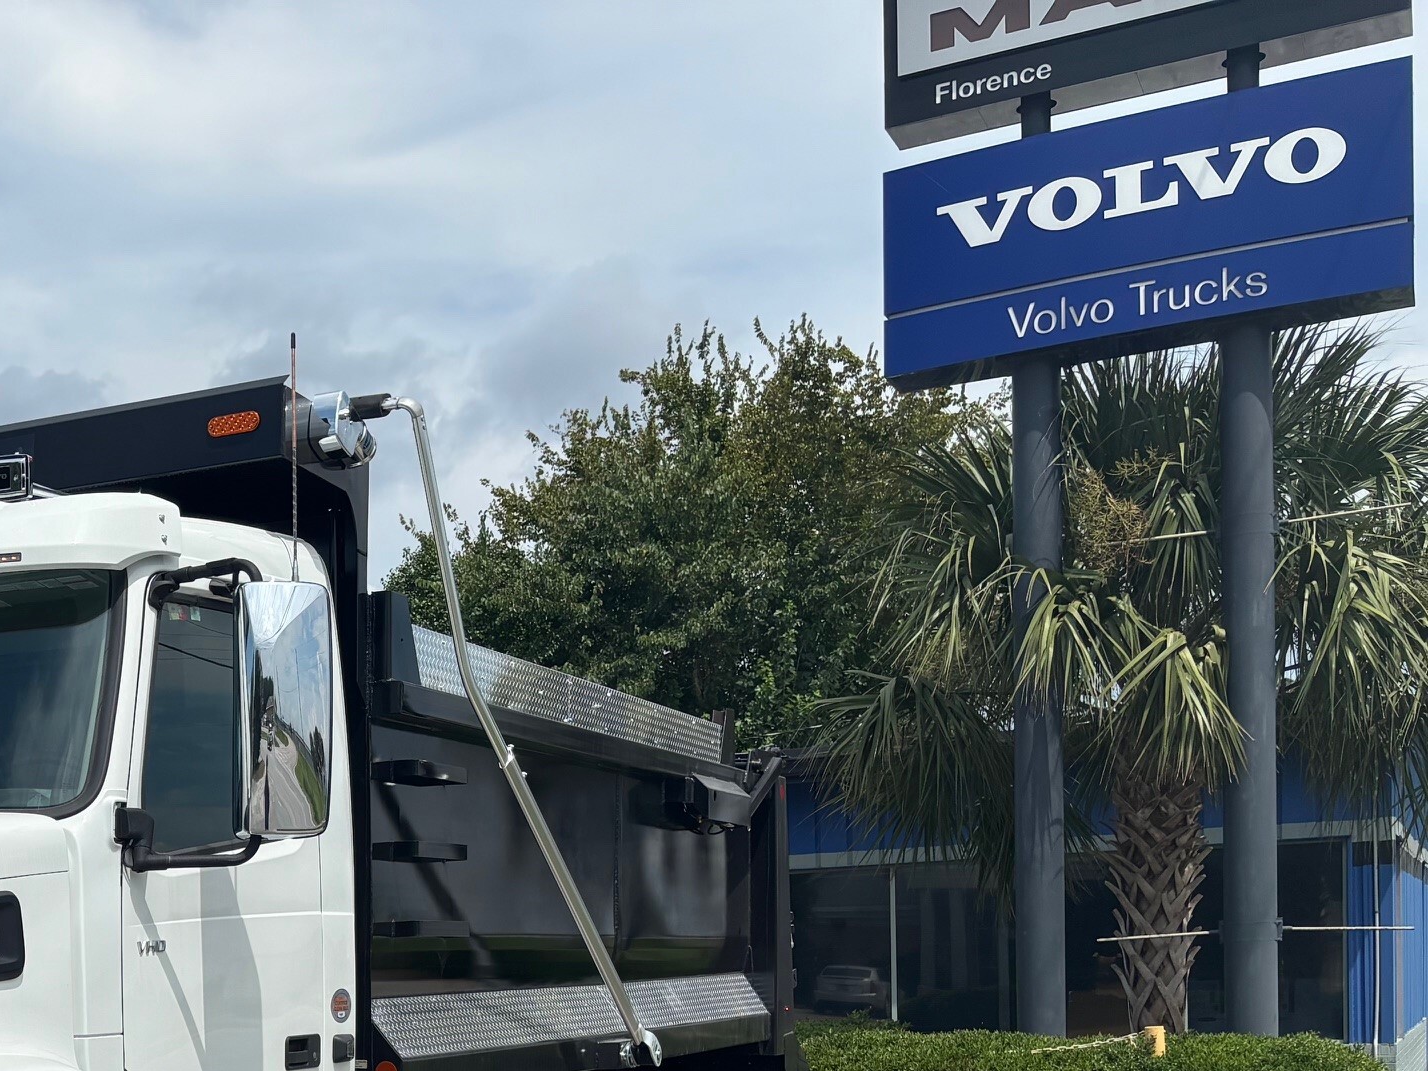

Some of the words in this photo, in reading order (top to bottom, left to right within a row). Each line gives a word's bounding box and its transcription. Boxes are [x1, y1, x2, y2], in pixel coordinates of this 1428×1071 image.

[930, 0, 1143, 52] M
[935, 62, 1052, 104] Florence
[936, 126, 1347, 248] VOLVO
[1007, 296, 1115, 338] Volvo
[1129, 267, 1268, 318] Trucks
[137, 940, 166, 957] VHD
